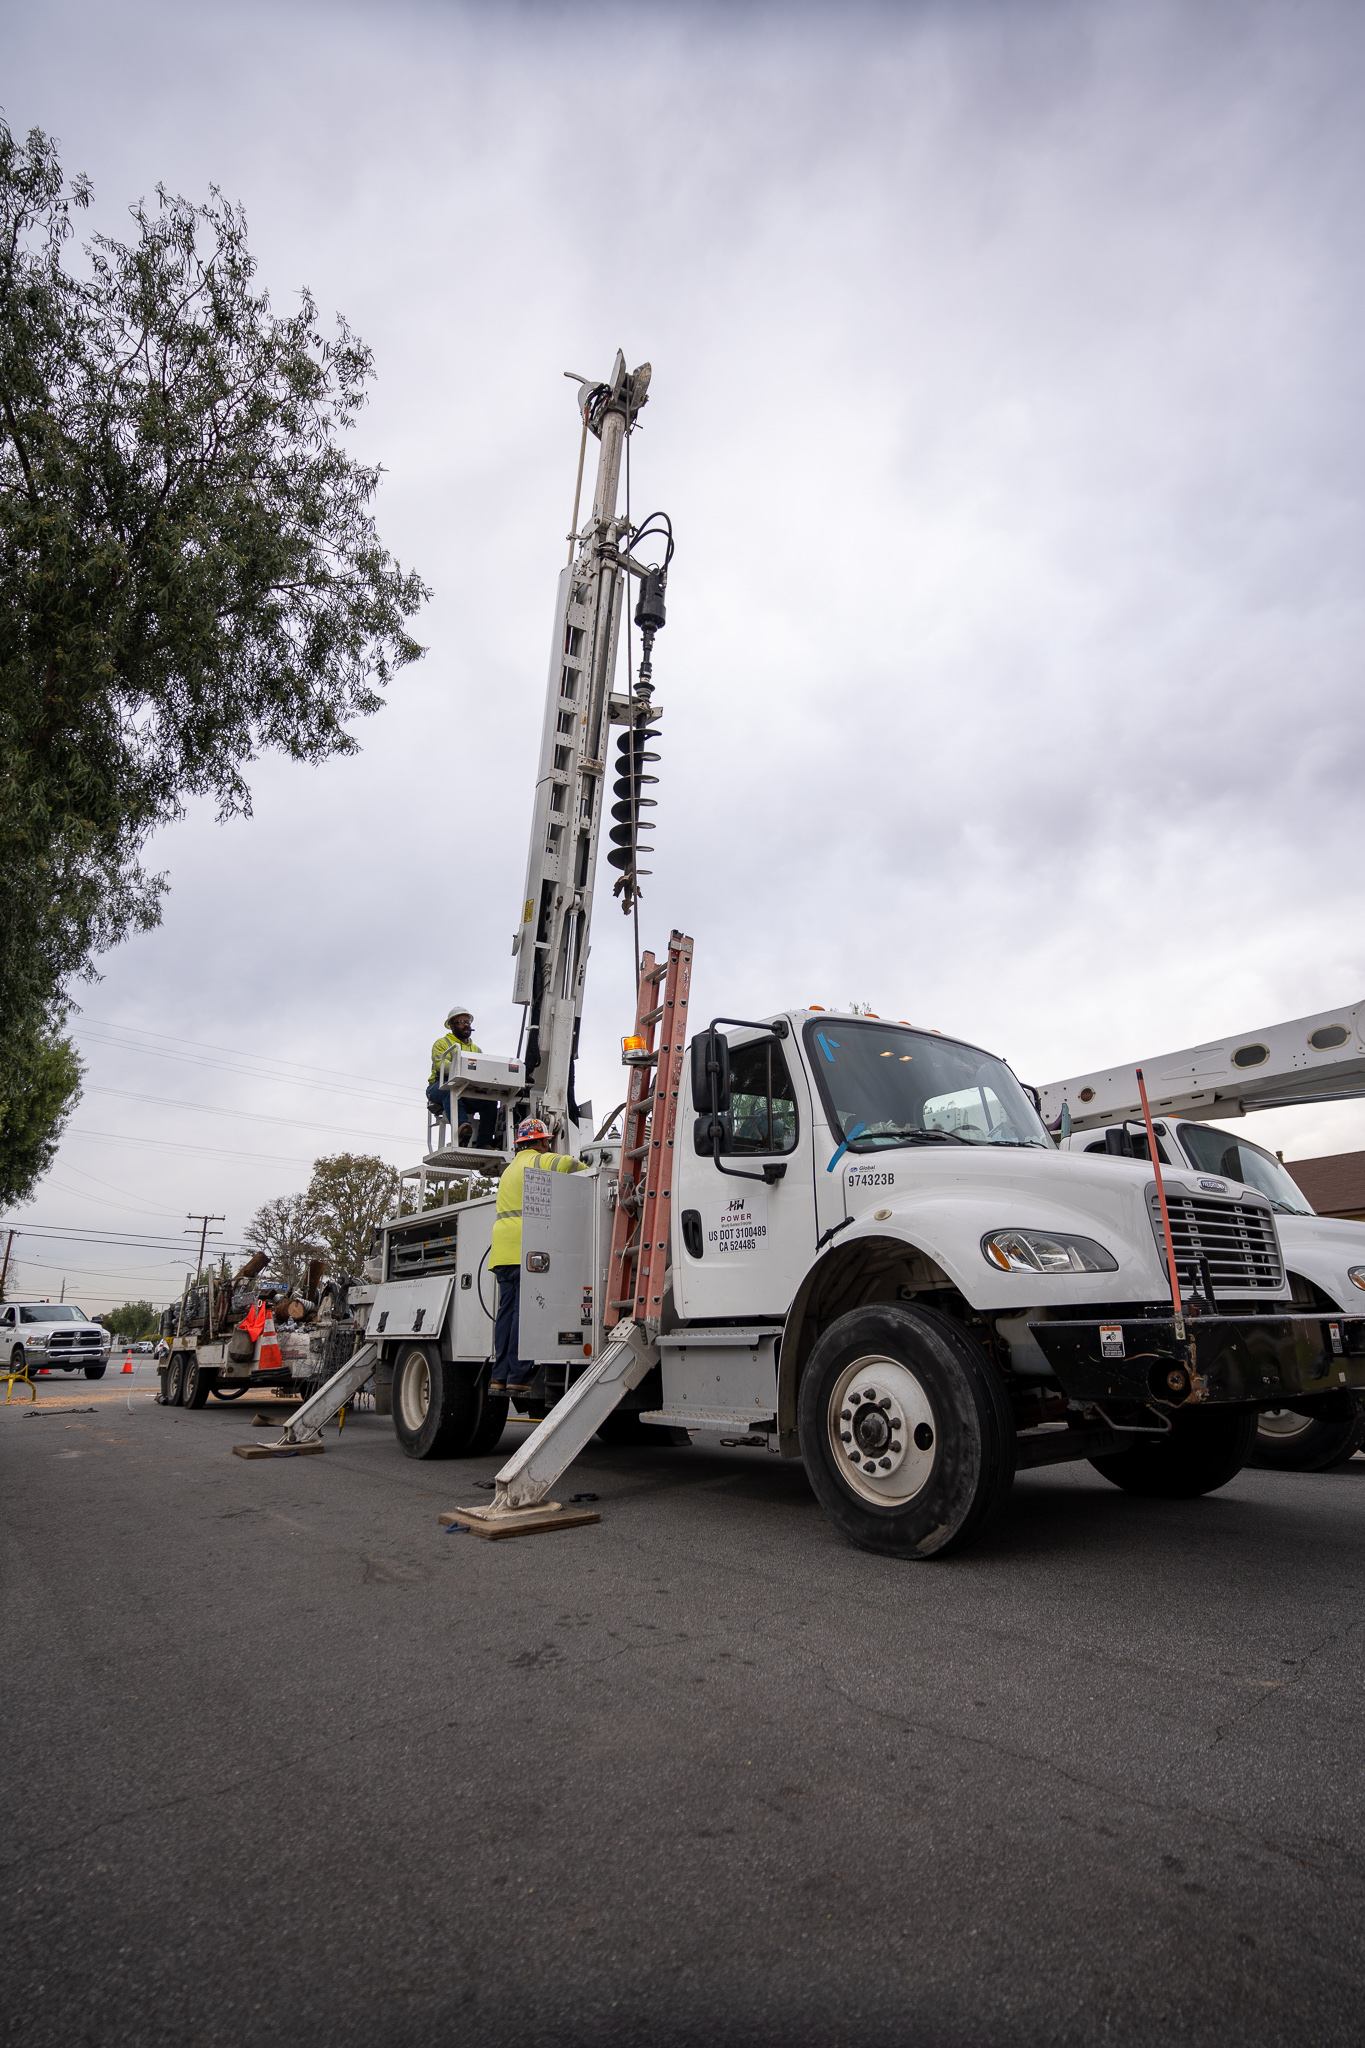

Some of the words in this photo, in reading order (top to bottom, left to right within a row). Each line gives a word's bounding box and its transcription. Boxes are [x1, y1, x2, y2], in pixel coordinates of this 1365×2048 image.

[848, 1173, 895, 1187] 974323B
[721, 1213, 752, 1223] POWER
[708, 1231, 718, 1242] US
[720, 1229, 734, 1240] DOT
[735, 1225, 767, 1239] 3100489
[719, 1241, 729, 1252] CA
[730, 1239, 756, 1251] 524485
